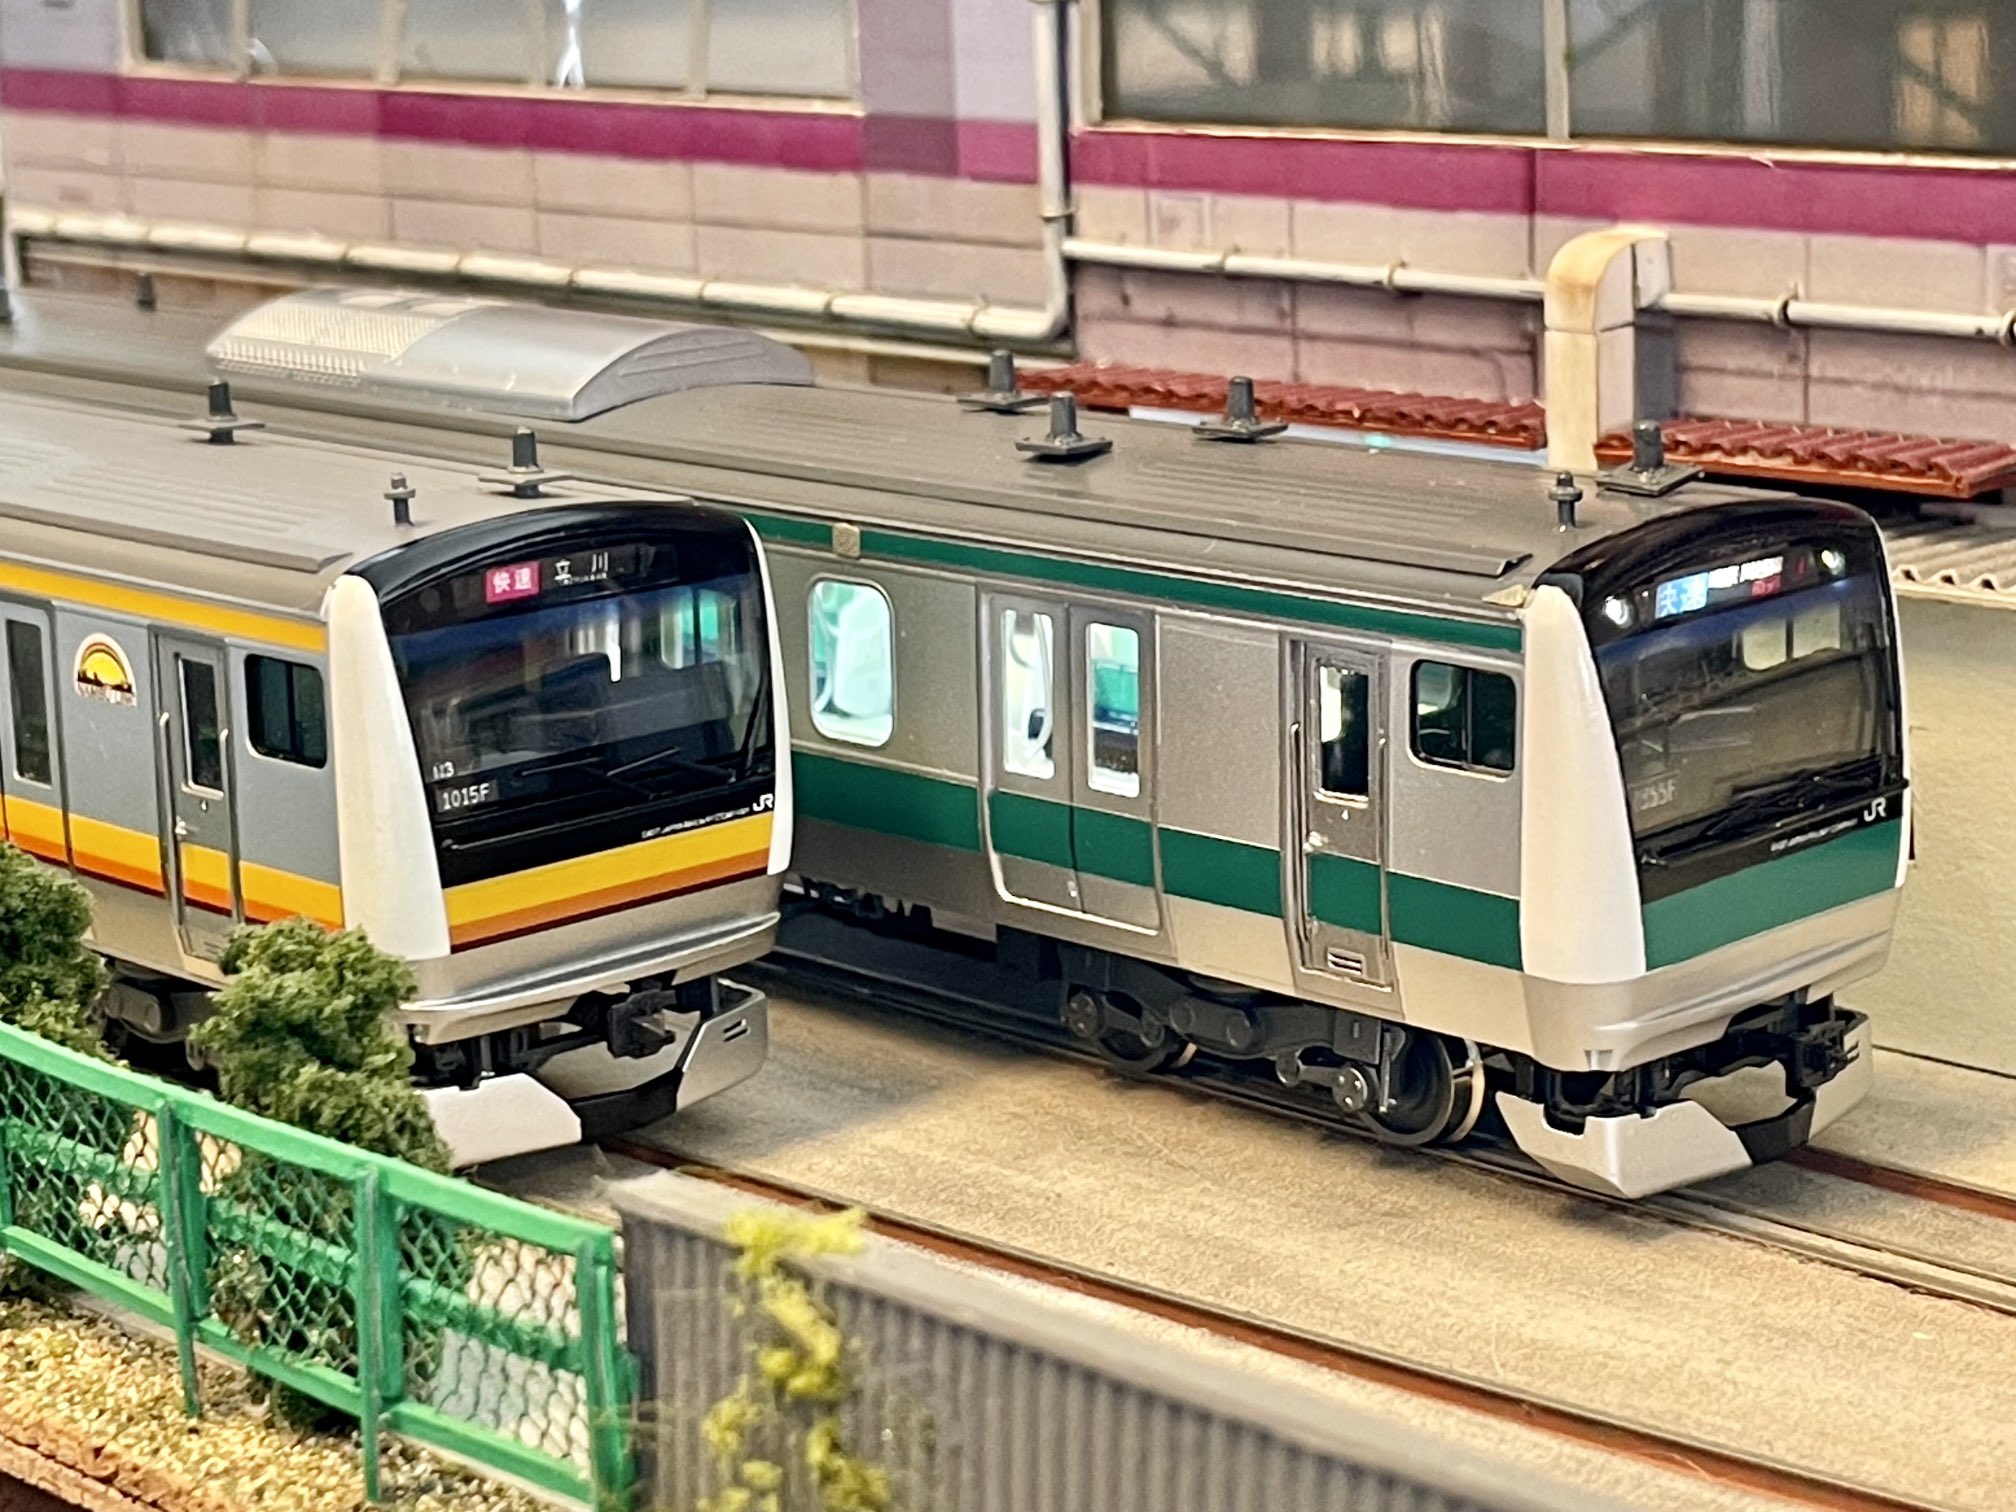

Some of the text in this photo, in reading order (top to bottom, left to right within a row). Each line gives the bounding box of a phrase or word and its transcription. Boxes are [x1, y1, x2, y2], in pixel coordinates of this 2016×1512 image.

[442, 782, 491, 810] 1015F
[752, 793, 774, 812] JR
[1864, 797, 1887, 822] JR
